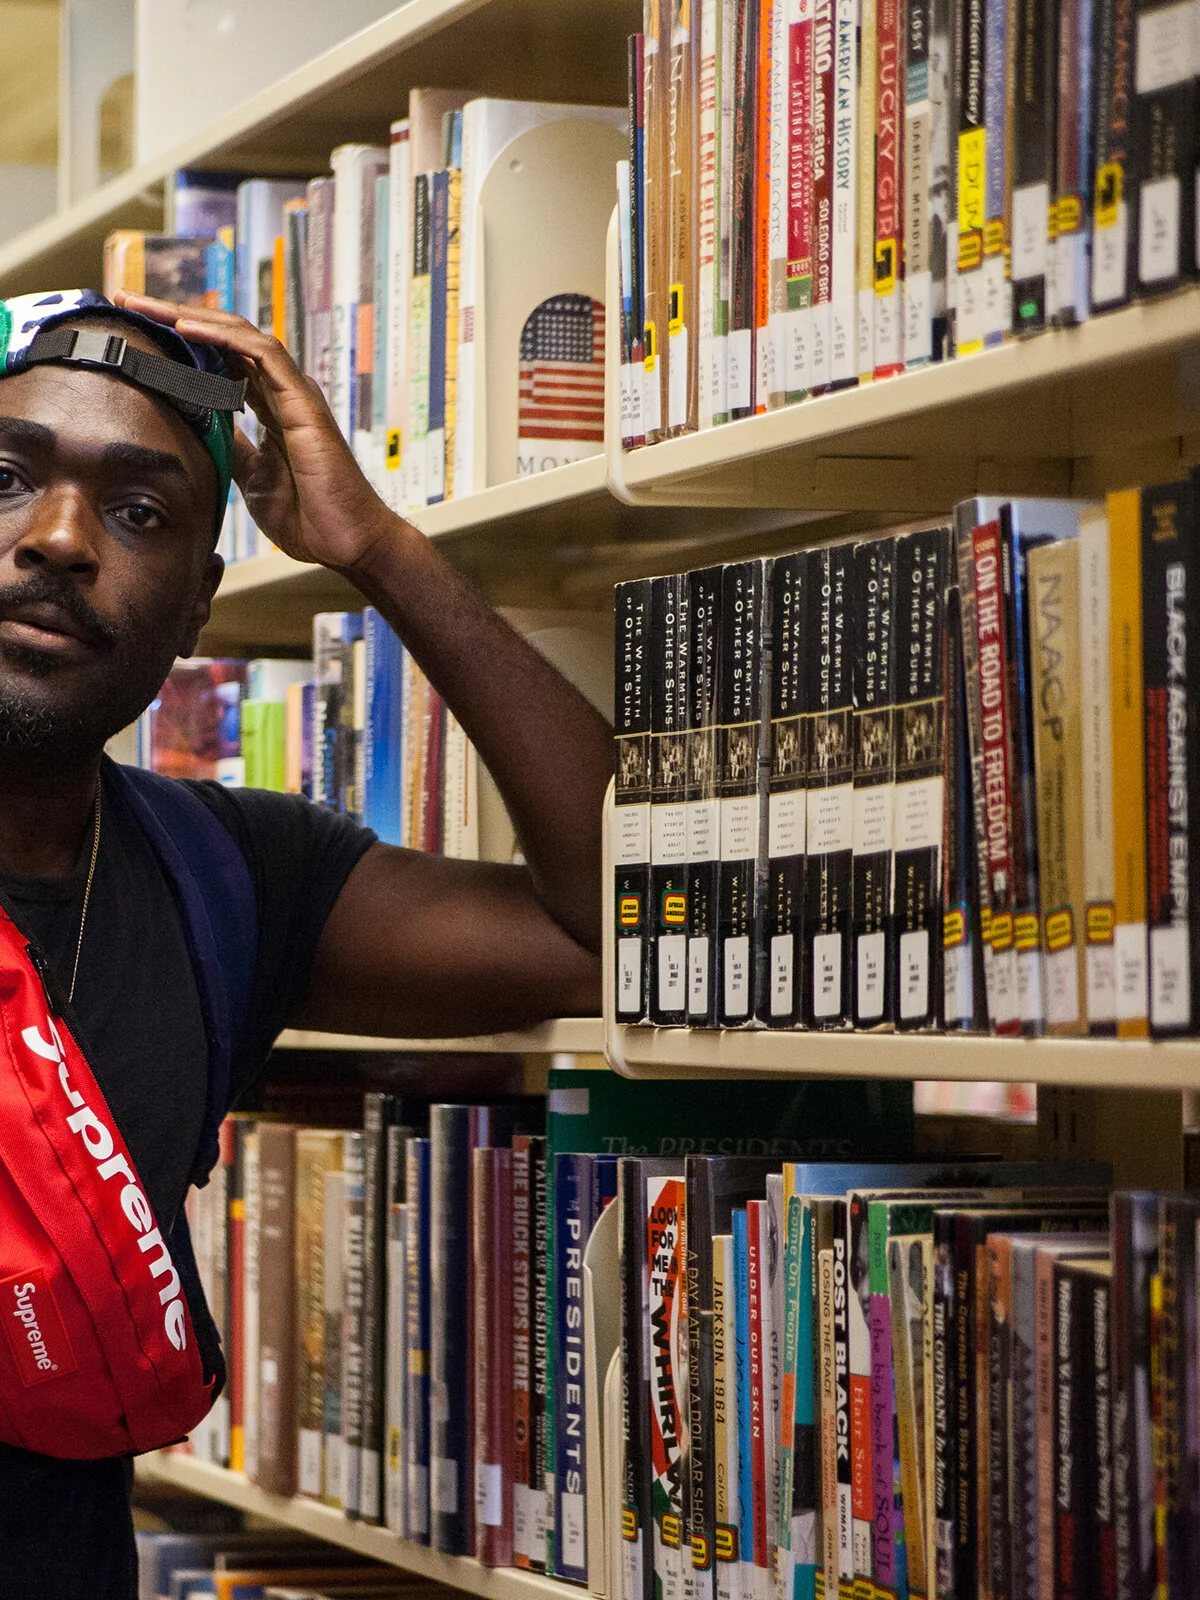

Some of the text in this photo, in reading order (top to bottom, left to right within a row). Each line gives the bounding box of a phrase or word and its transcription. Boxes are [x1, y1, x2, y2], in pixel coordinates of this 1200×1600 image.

[912, 9, 924, 51] LOST
[669, 55, 682, 178] Nomad
[771, 59, 782, 169] AMERICAN
[791, 80, 803, 209] LATINO HISTORY
[814, 91, 825, 181] AMERICA
[880, 43, 895, 161] LUCKY
[966, 59, 981, 125] History
[837, 117, 852, 190] HISTORY
[912, 120, 921, 182] DANIEL
[818, 198, 830, 262] SOLEDAD
[624, 597, 633, 727] OF OTHER SUNS
[634, 603, 644, 718] THE WARMTH
[665, 592, 675, 725] OF OTHER SUNS
[678, 599, 688, 715] THE WARMTH
[695, 586, 705, 721] OF OTHER SUNS
[705, 636, 713, 711] WARMTH
[733, 579, 743, 716] OF OTHER SUNS
[744, 585, 755, 706] THE WARMTH
[780, 570, 791, 710] OF OTHER SUNS
[791, 621, 800, 700] WARMTH
[820, 562, 831, 704] OF OTHER SUNS
[833, 567, 845, 693] THE WARMTH
[866, 557, 878, 702] OF OTHER SUNS
[879, 563, 891, 691] THE WARMTH
[909, 547, 922, 695] OF OTHER SUNS
[923, 553, 937, 683] THE WARMTH
[1039, 572, 1064, 743] NAACP
[1166, 561, 1187, 680] BLACK
[975, 555, 1008, 862] ON THE ROAD TO FREEDOM
[1168, 687, 1188, 829] AGAINST
[21, 1013, 188, 1352] Supreme
[535, 1159, 547, 1251] FAILURES
[651, 1231, 674, 1249] FOR
[513, 1151, 529, 1391] THE BUCK STOPS HERE
[652, 1255, 669, 1273] ME
[652, 1278, 675, 1297] THE
[687, 1249, 698, 1262] A
[687, 1267, 699, 1300] DAY
[749, 1246, 757, 1321] UNDER
[785, 1202, 800, 1362] Come On, People
[13, 1282, 52, 1372] Supreme
[535, 1272, 547, 1396] PRESIDENTS
[565, 1218, 582, 1494] PRESIDENTS
[688, 1305, 700, 1349] LATE
[689, 1354, 700, 1387] AND
[713, 1277, 725, 1424] JACKSON, 1964
[822, 1259, 832, 1400] LOSING THE RACE
[833, 1238, 849, 1462] POST BLACK
[873, 1318, 885, 1354] the
[933, 1302, 945, 1335] THE
[690, 1392, 701, 1405] A
[752, 1386, 760, 1439] SKIN
[874, 1403, 887, 1452] book
[934, 1339, 947, 1432] COVENANT
[690, 1410, 703, 1483] DOLLAR
[717, 1462, 725, 1513] Calvin
[853, 1387, 865, 1510] Hair Story
[840, 1493, 848, 1549] WOMACK
[874, 1492, 891, 1571] SOUL
